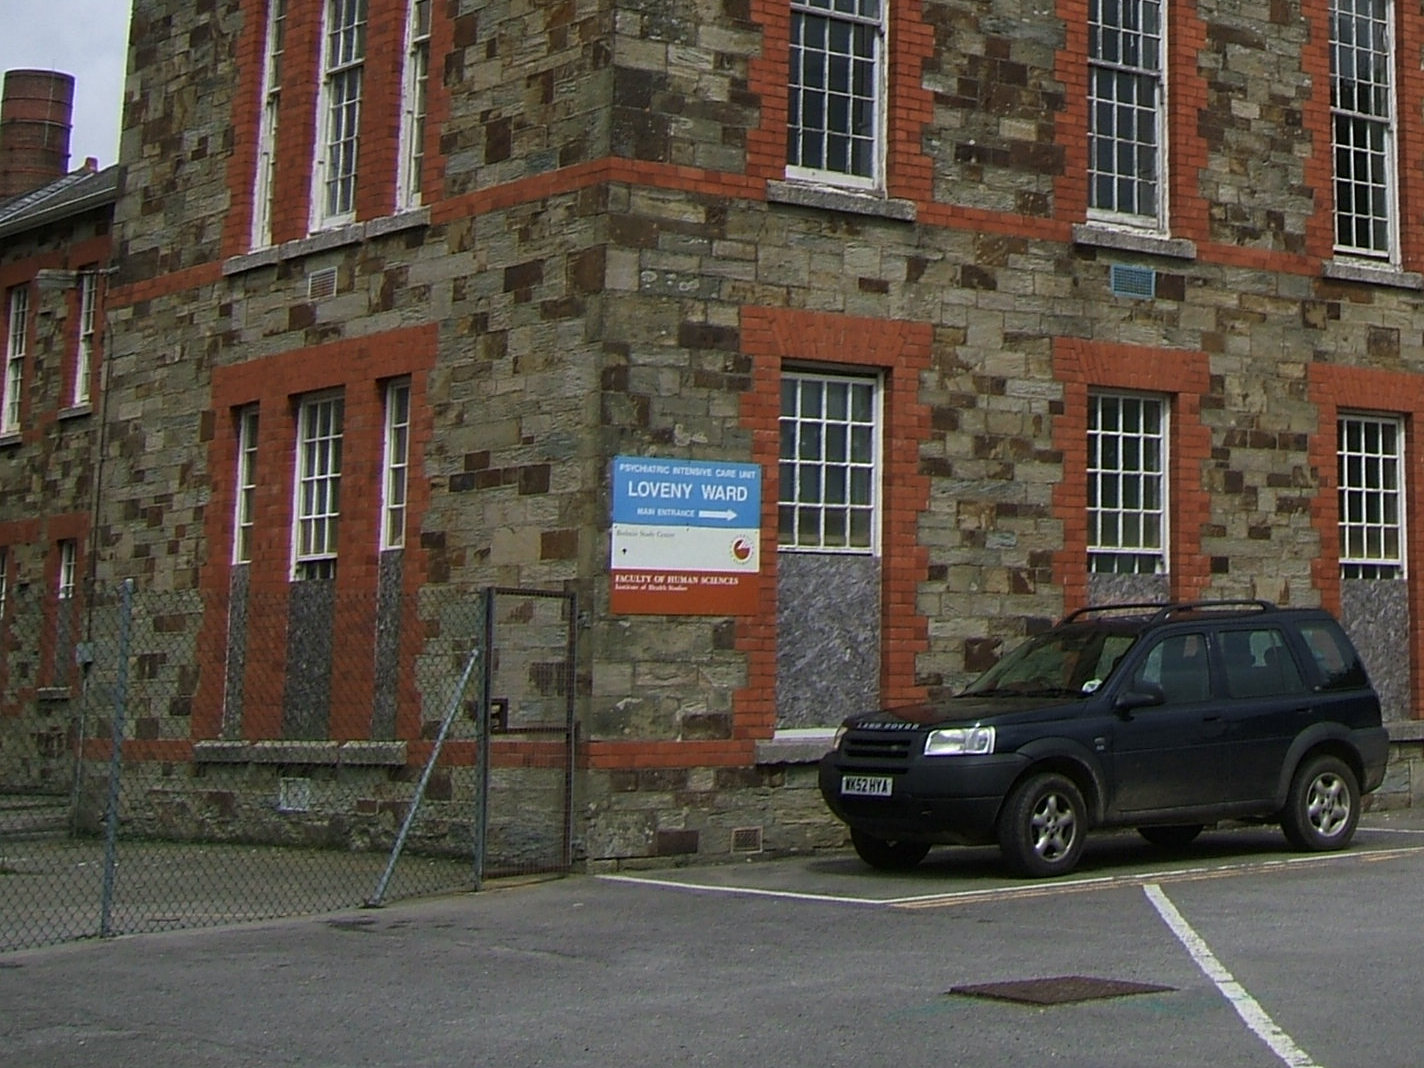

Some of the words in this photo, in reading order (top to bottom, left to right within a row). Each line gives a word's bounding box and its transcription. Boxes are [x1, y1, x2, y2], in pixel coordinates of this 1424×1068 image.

[619, 463, 670, 475] PSYCHIATRIC
[672, 466, 712, 477] INTENSIVE
[715, 468, 736, 479] CARE
[739, 470, 756, 480] UNIT
[628, 481, 693, 499] LOVENY
[701, 484, 748, 502] WARD
[637, 507, 655, 516] MAIN
[657, 509, 695, 518] ENTRANCE
[615, 574, 652, 583] FACULTY
[654, 575, 666, 584] OF
[667, 576, 699, 584] HUMAN
[701, 576, 739, 585] SCIENCES
[883, 722, 920, 730] ROVER
